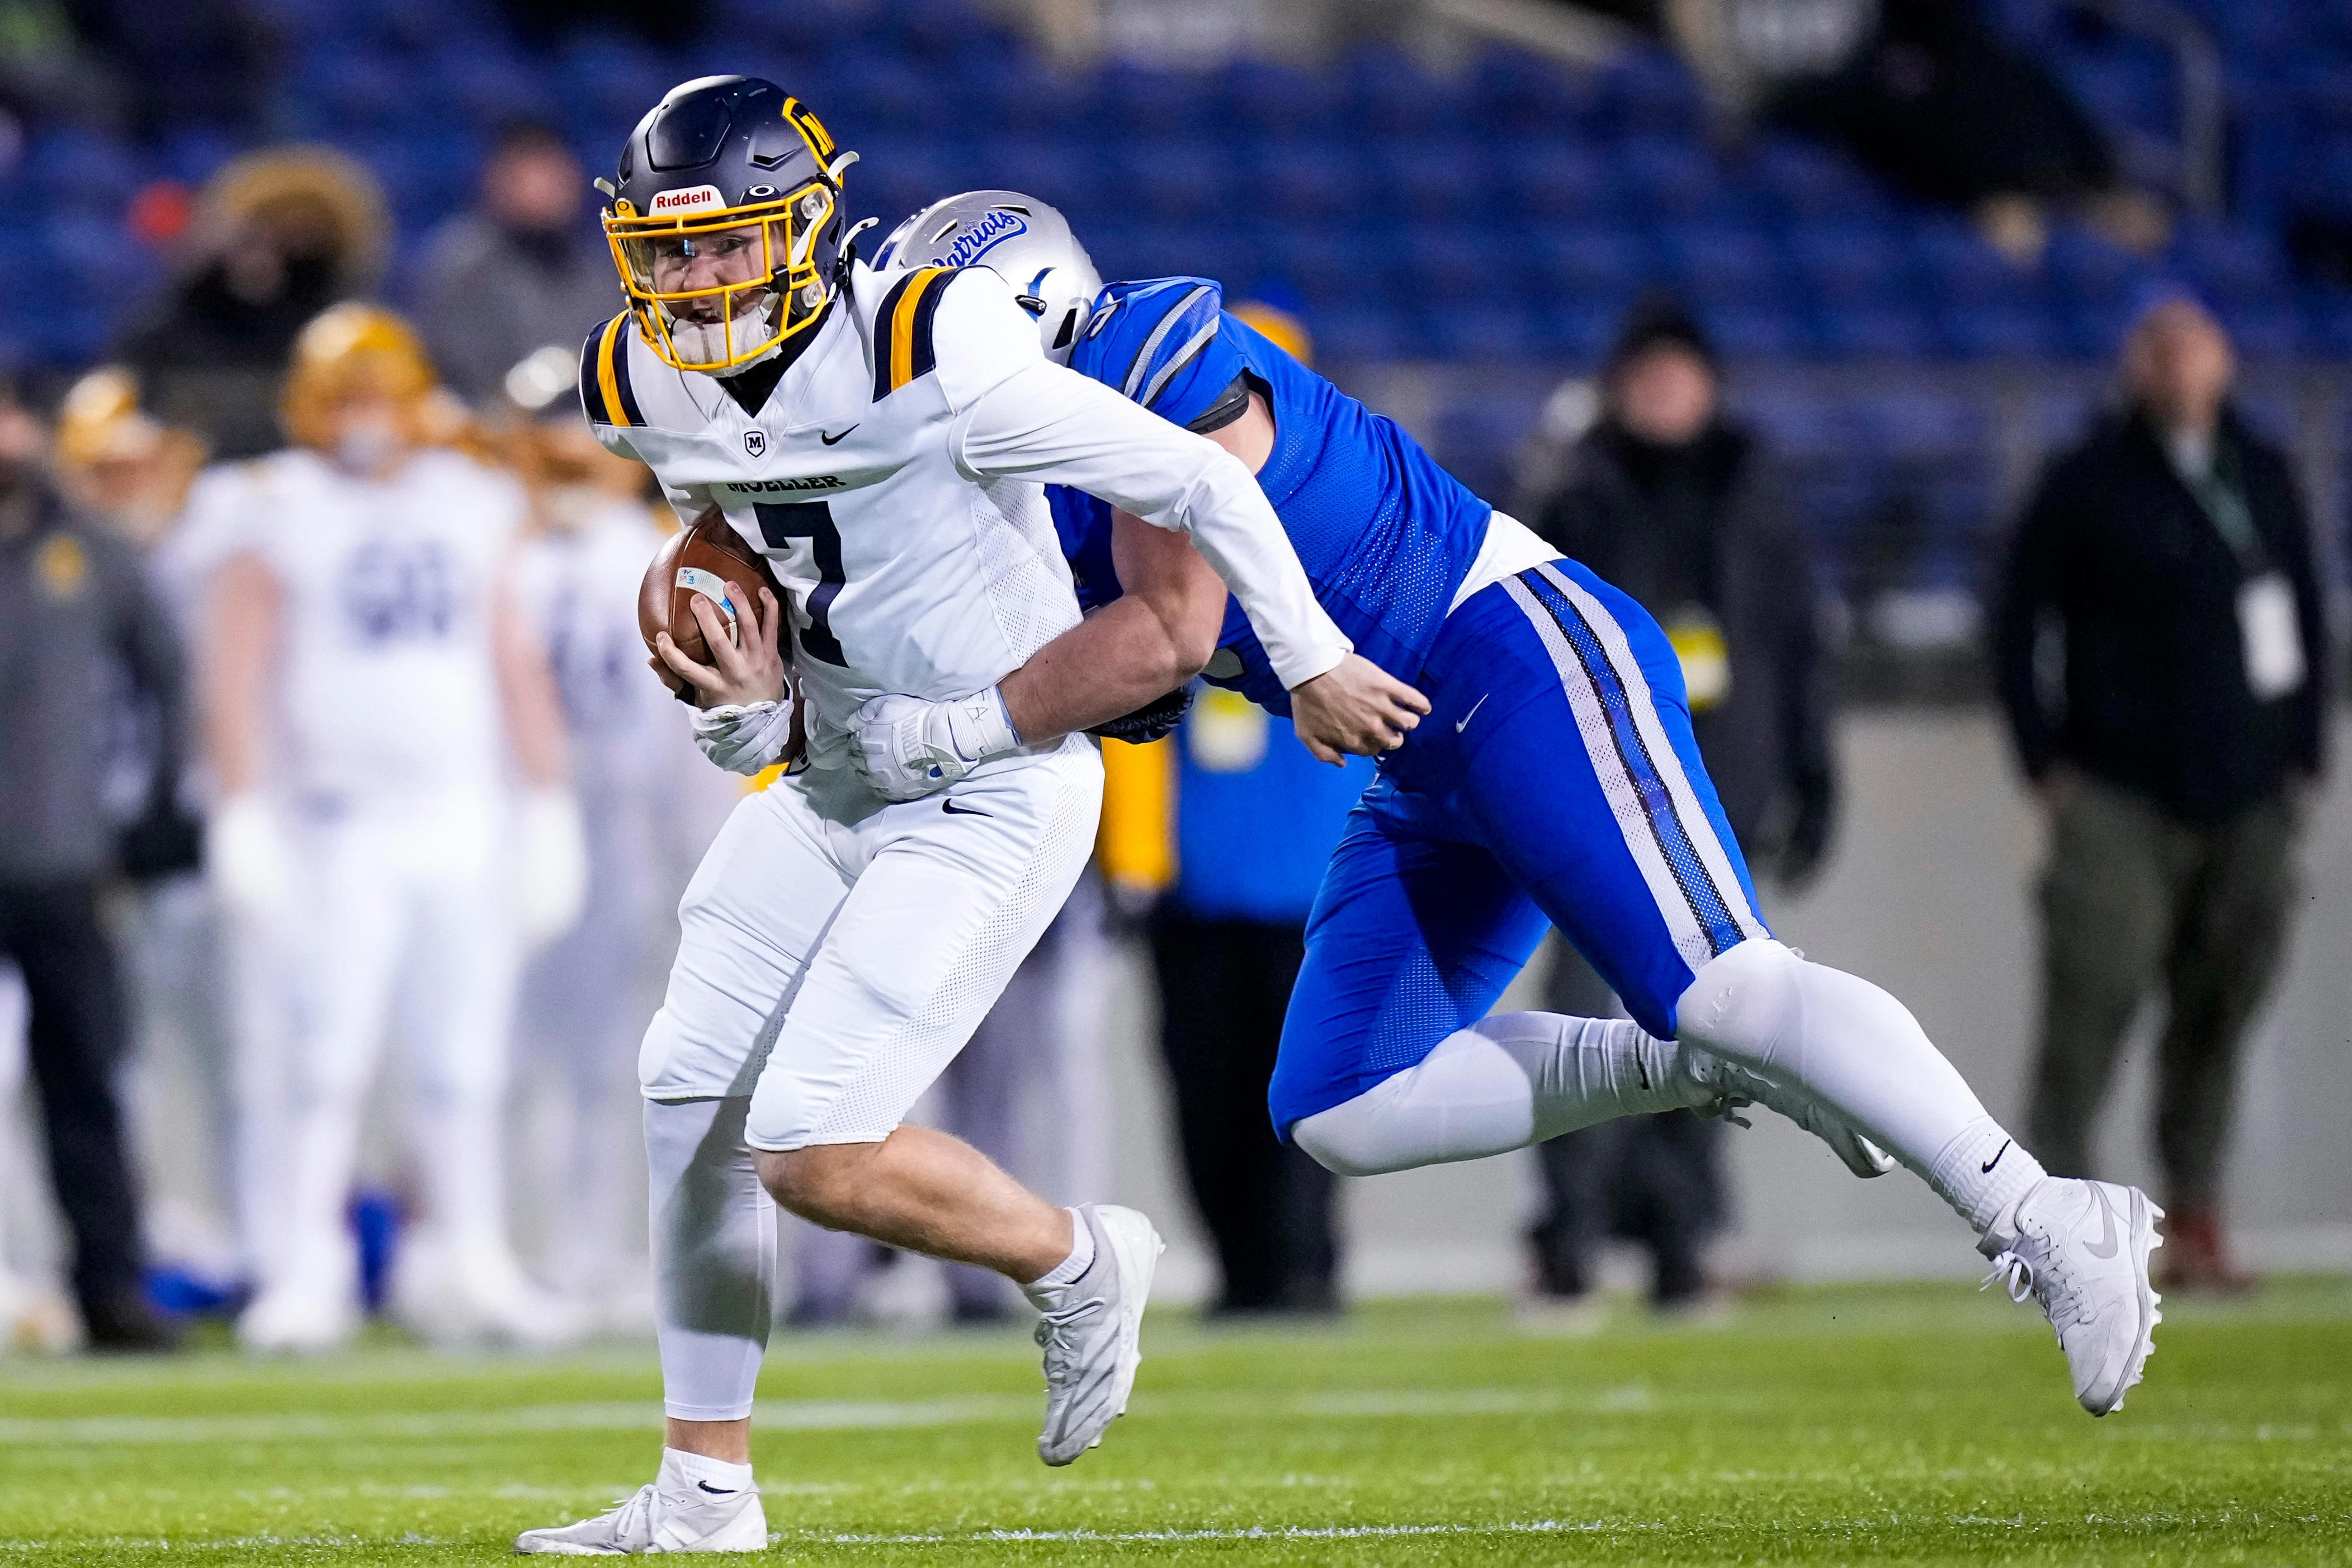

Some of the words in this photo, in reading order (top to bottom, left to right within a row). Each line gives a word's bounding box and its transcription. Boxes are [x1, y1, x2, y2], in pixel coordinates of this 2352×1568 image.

[657, 191, 711, 208] Riddell
[748, 437, 762, 448] M
[727, 475, 847, 493] MOELLER
[752, 500, 850, 669] 7
